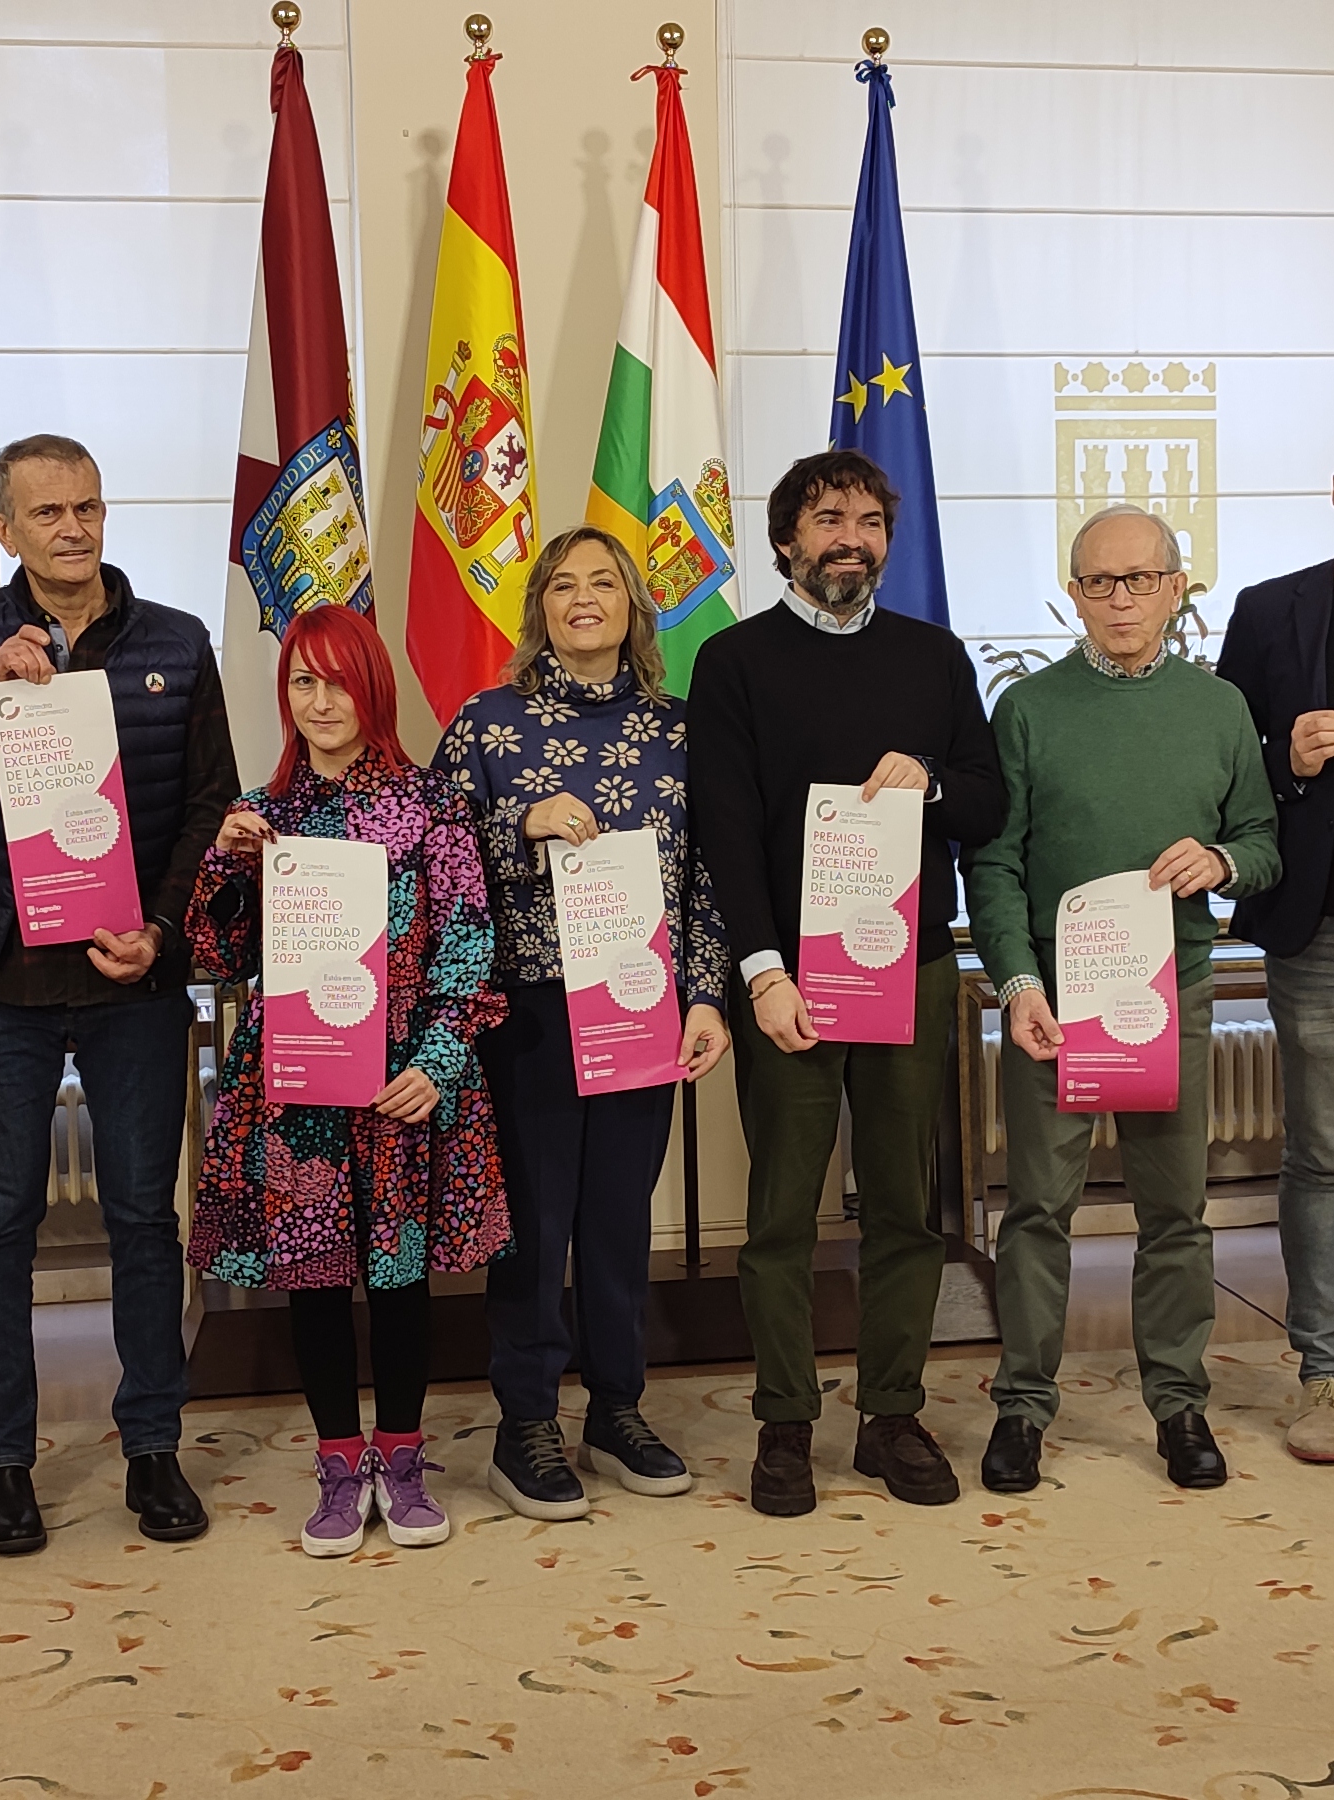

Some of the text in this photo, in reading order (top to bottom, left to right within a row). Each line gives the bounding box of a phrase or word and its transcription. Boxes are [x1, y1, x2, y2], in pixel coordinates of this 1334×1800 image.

[244, 443, 326, 599] LEAL CIUDAD DE
[0, 726, 55, 742] PREMIOS
[6, 761, 93, 781] DE LA CIUDAD
[8, 773, 95, 794] DE LOGROÑO
[10, 795, 40, 807] 2023
[814, 831, 864, 844] PREMIOS
[812, 869, 894, 884] DE LA CIUDAD
[273, 886, 327, 897] PREMIOS
[564, 880, 613, 895] PREMIOS
[811, 882, 892, 897] DE LOGROÑO
[810, 895, 837, 906] 2023
[568, 916, 644, 933] DE LA CIUDAD
[1065, 919, 1115, 933] PREMIOS
[273, 927, 360, 937] DE LA CIUDAD
[569, 927, 645, 946] DE LOGROÑO
[273, 938, 359, 951] DE LOGROÑO
[272, 953, 301, 963] 2023
[571, 947, 598, 959] 2023
[1065, 955, 1148, 969] DE LA CIUDAD
[1066, 966, 1148, 981] DE LOGROÑO
[1066, 983, 1094, 994] 2023
